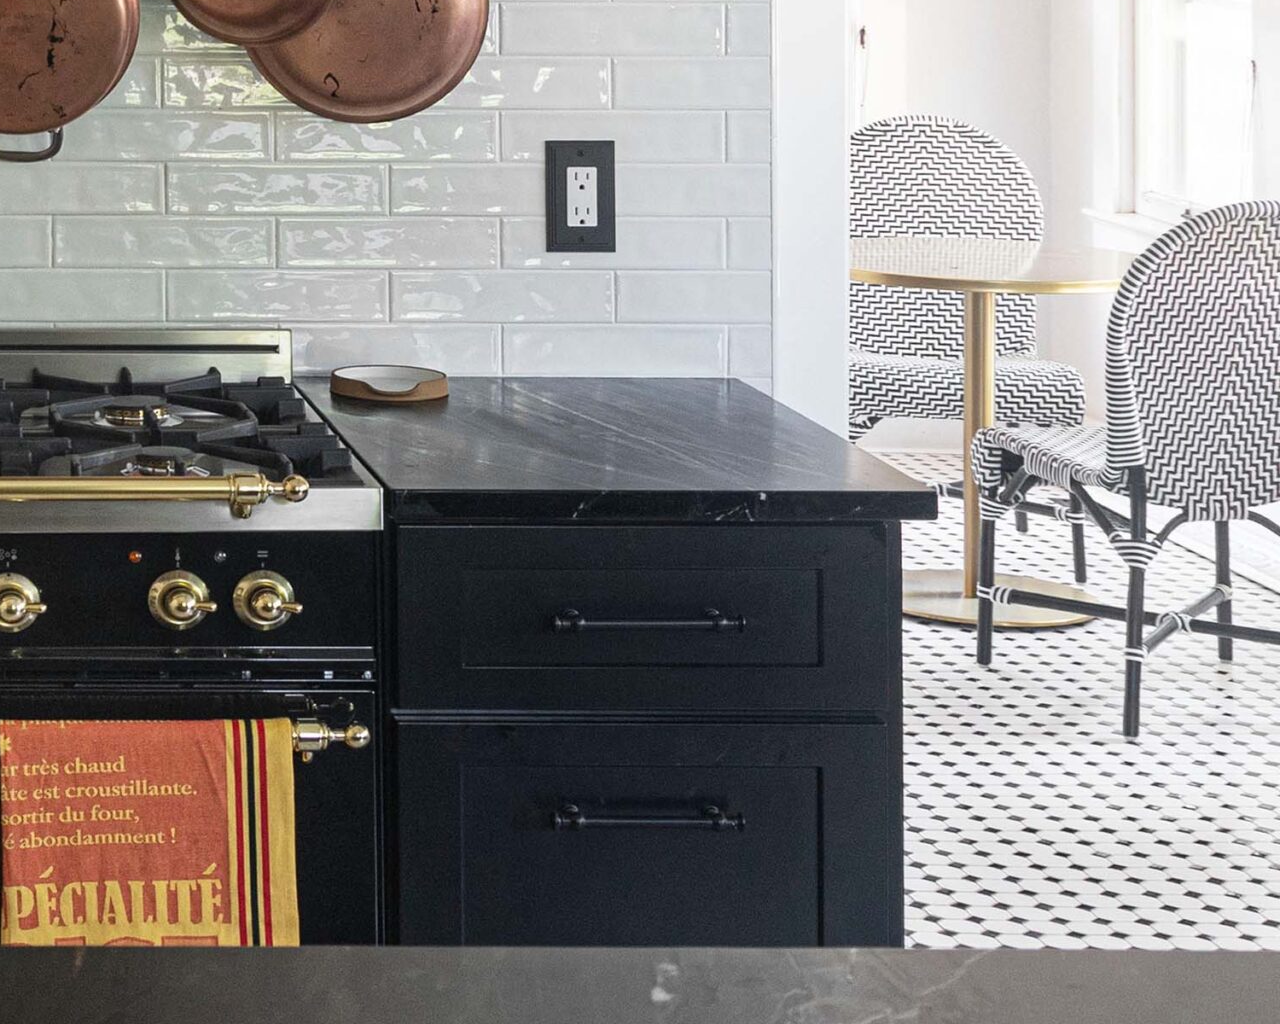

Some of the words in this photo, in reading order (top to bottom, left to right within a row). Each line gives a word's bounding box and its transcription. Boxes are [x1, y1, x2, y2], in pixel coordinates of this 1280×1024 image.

[23, 758, 59, 776] très
[64, 756, 126, 774] chaud
[33, 786, 60, 799] est
[65, 779, 197, 798] croustillante.
[1, 807, 54, 825] sortir
[59, 806, 85, 823] du
[90, 805, 139, 823] four,
[19, 829, 165, 848] abondamment
